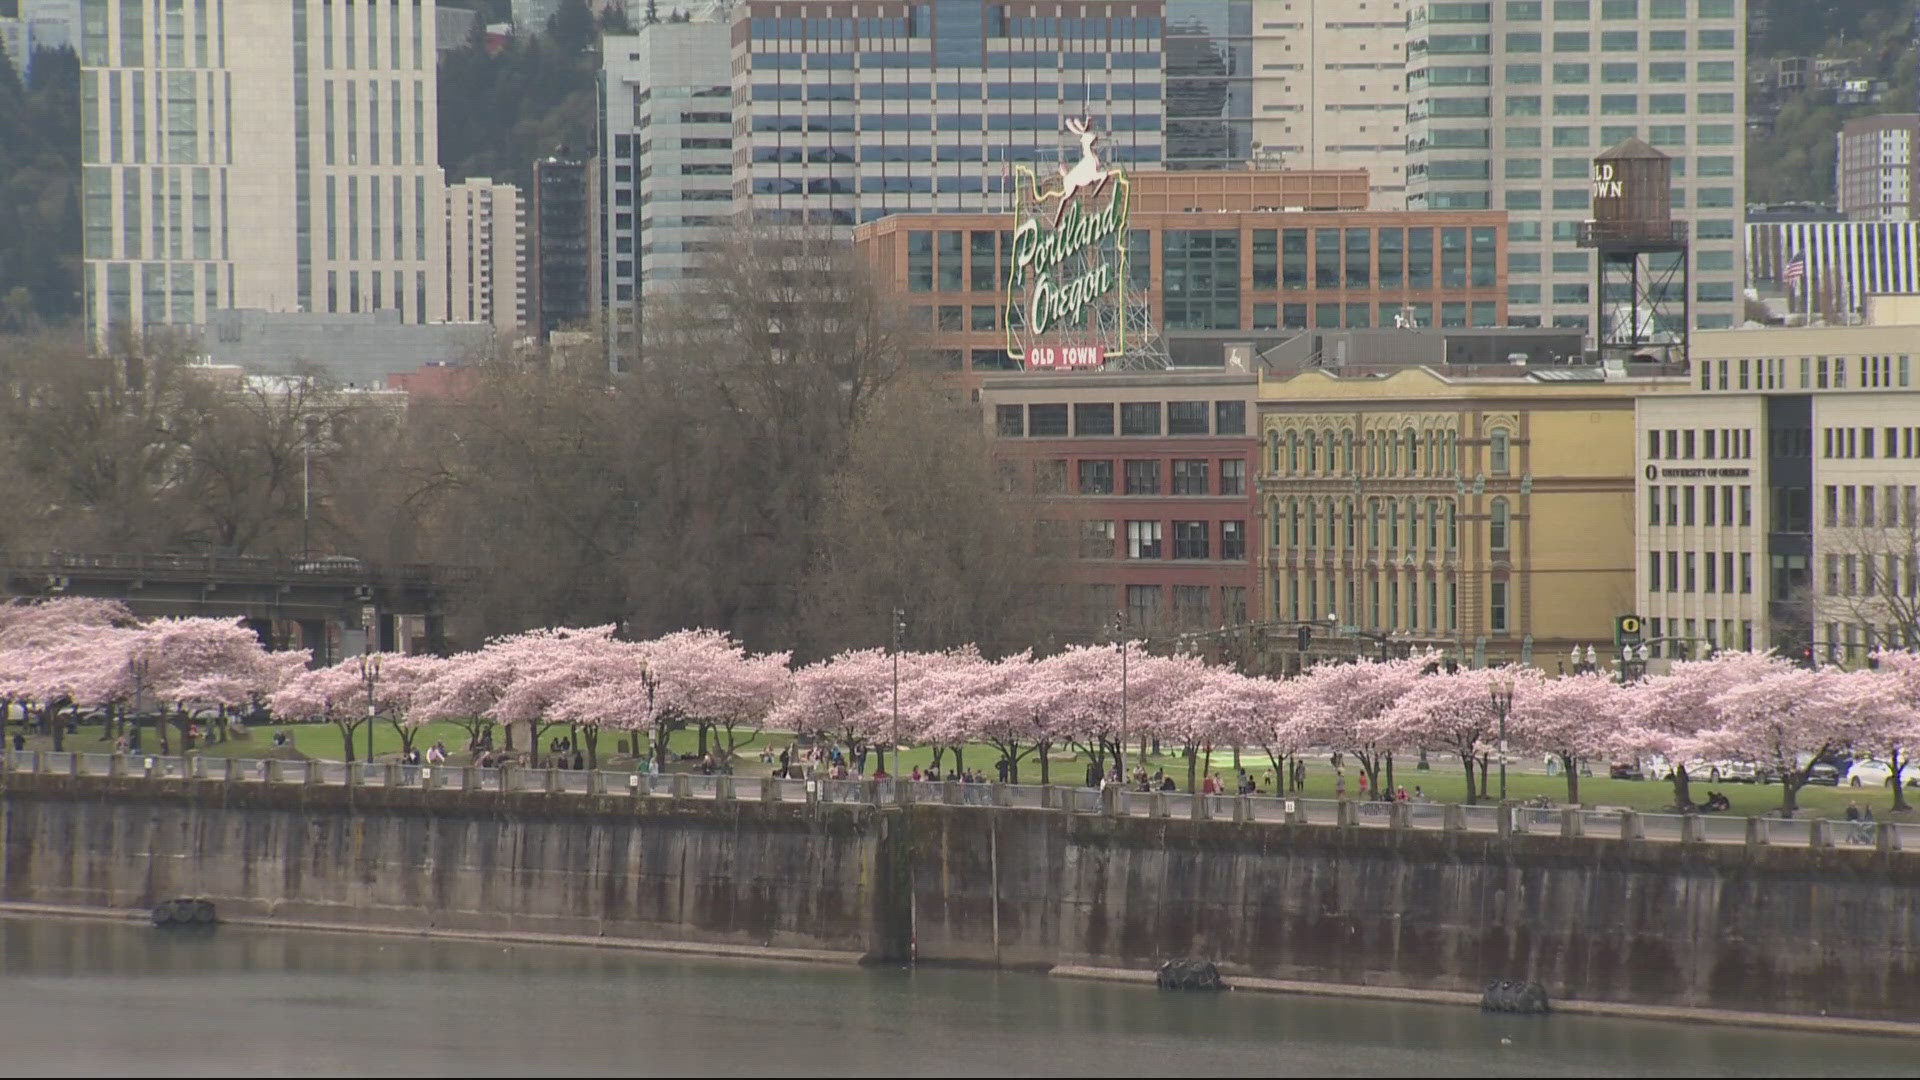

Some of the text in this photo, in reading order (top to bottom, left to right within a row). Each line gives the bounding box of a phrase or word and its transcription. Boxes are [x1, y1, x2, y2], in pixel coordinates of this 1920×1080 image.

[1593, 164, 1613, 181] LD
[1015, 178, 1119, 286] Portland
[1032, 262, 1110, 335] Oregon
[1031, 347, 1097, 365] OLD TOWN
[1707, 468, 1718, 477] OF
